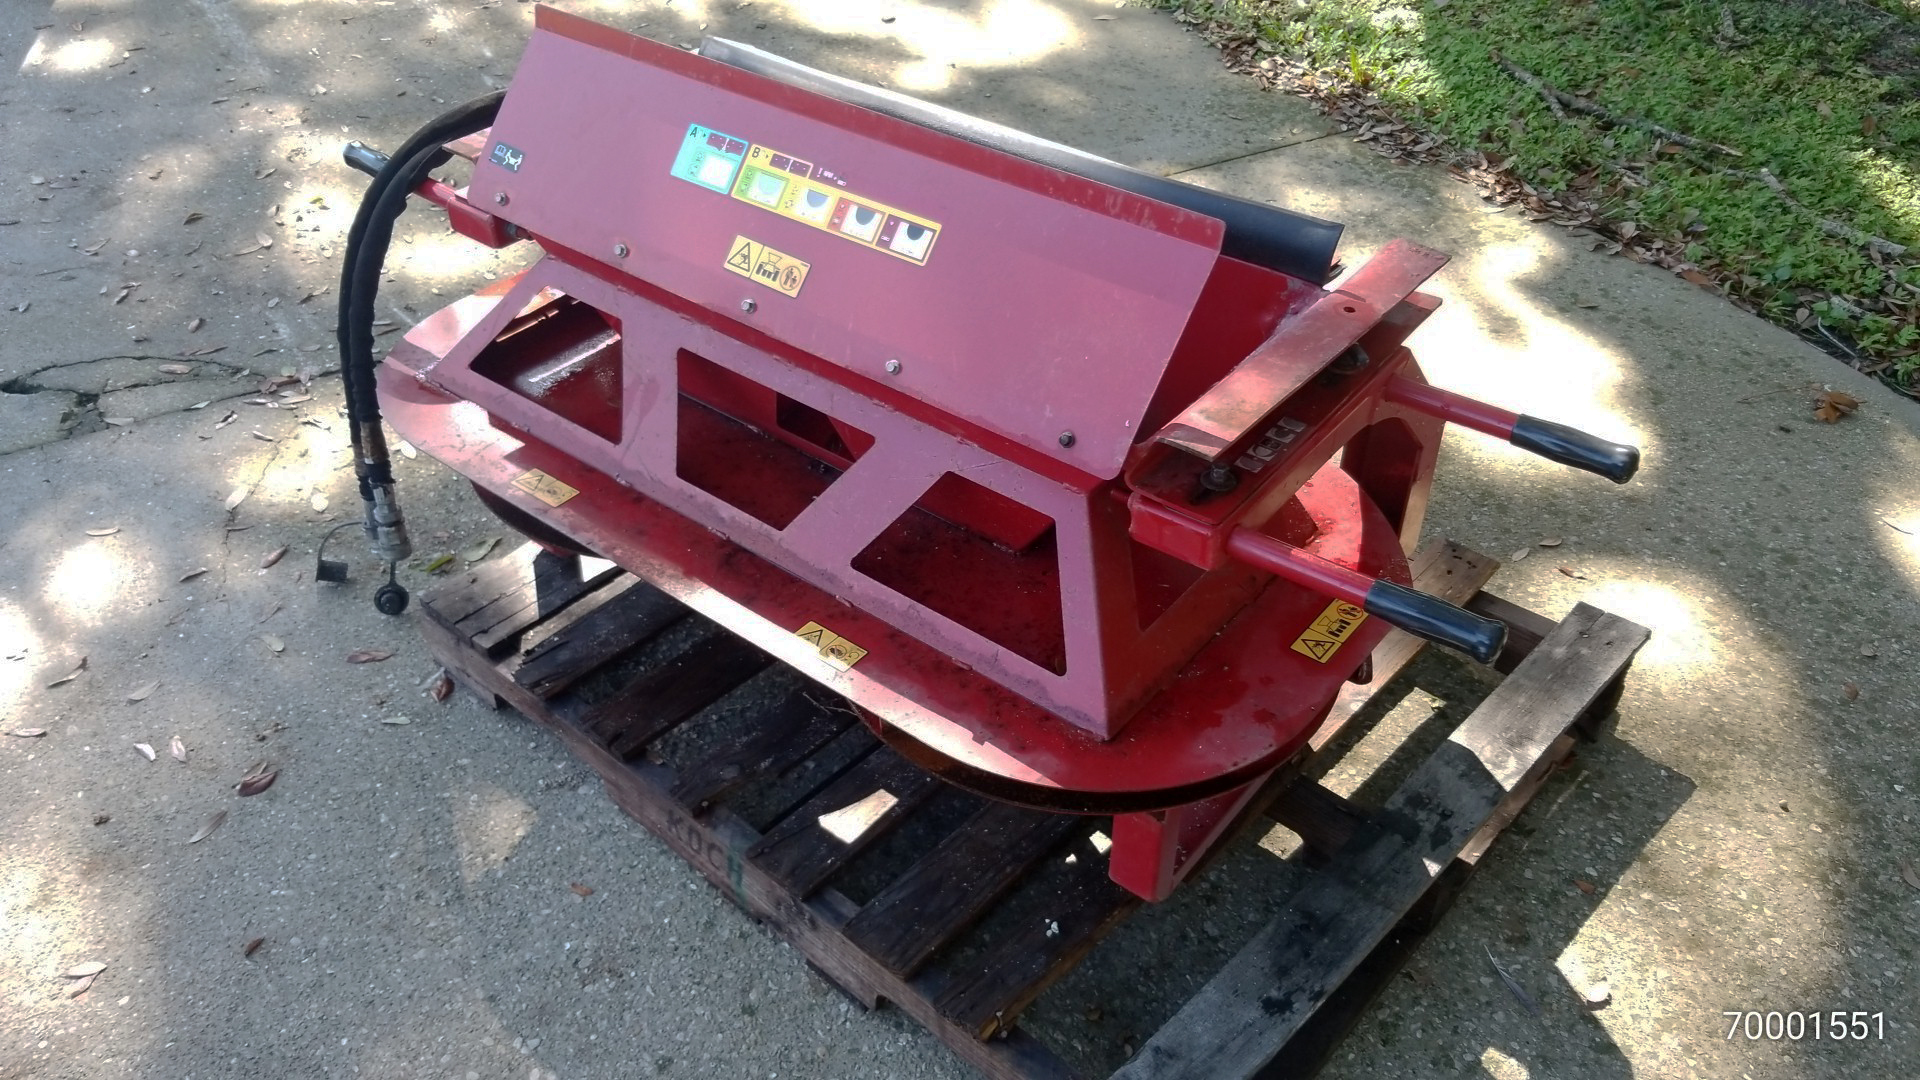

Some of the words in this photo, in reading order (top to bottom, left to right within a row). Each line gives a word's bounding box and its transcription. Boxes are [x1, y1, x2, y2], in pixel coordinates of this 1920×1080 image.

[690, 126, 698, 138] A
[752, 146, 761, 158] B
[666, 809, 743, 889] KOCH
